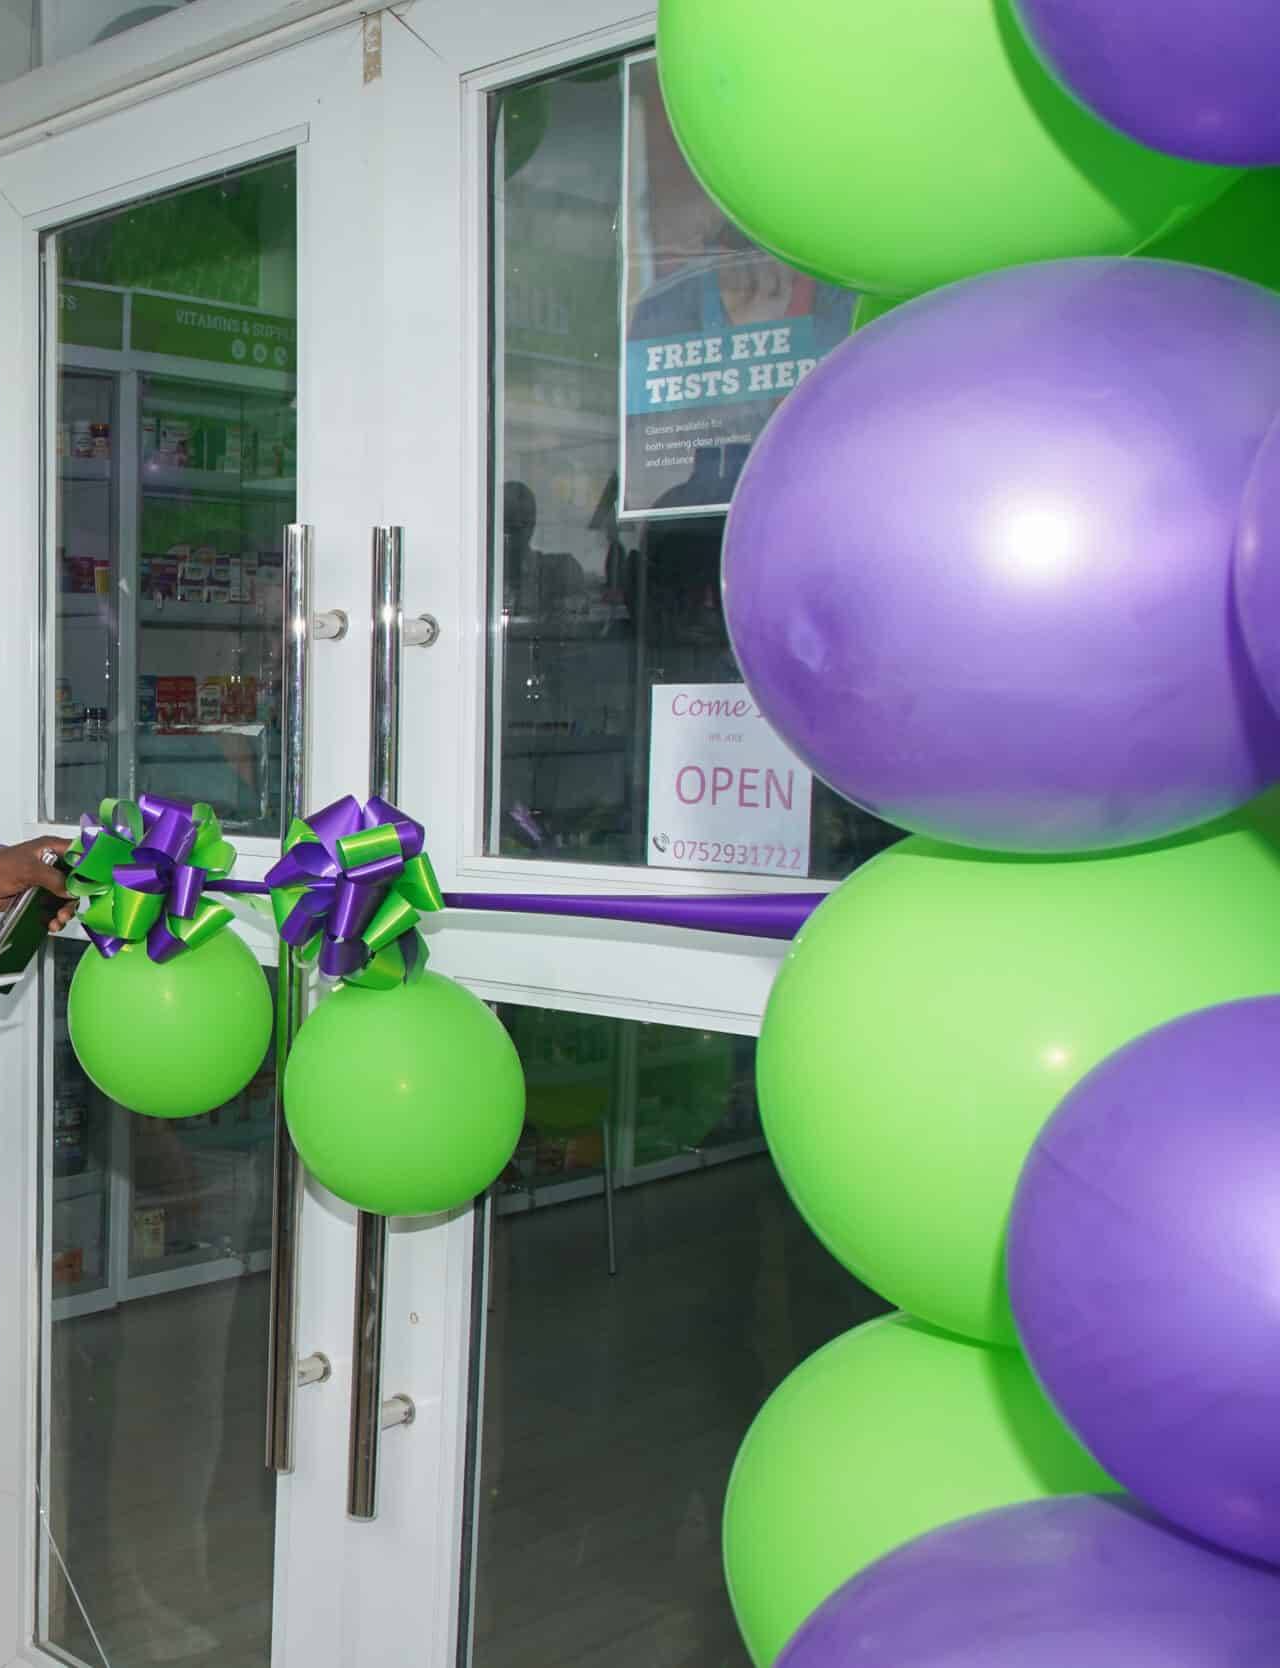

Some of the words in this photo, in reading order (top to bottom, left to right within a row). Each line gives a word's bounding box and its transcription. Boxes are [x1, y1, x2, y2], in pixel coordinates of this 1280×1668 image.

[175, 309, 241, 333] VITAMINS
[647, 337, 723, 372] FREE
[731, 327, 791, 361] EYE
[645, 368, 740, 404] TESTS
[748, 358, 817, 392] HER
[672, 693, 751, 718] Come
[675, 765, 793, 811] OPEN
[672, 839, 801, 870] 0752931722
